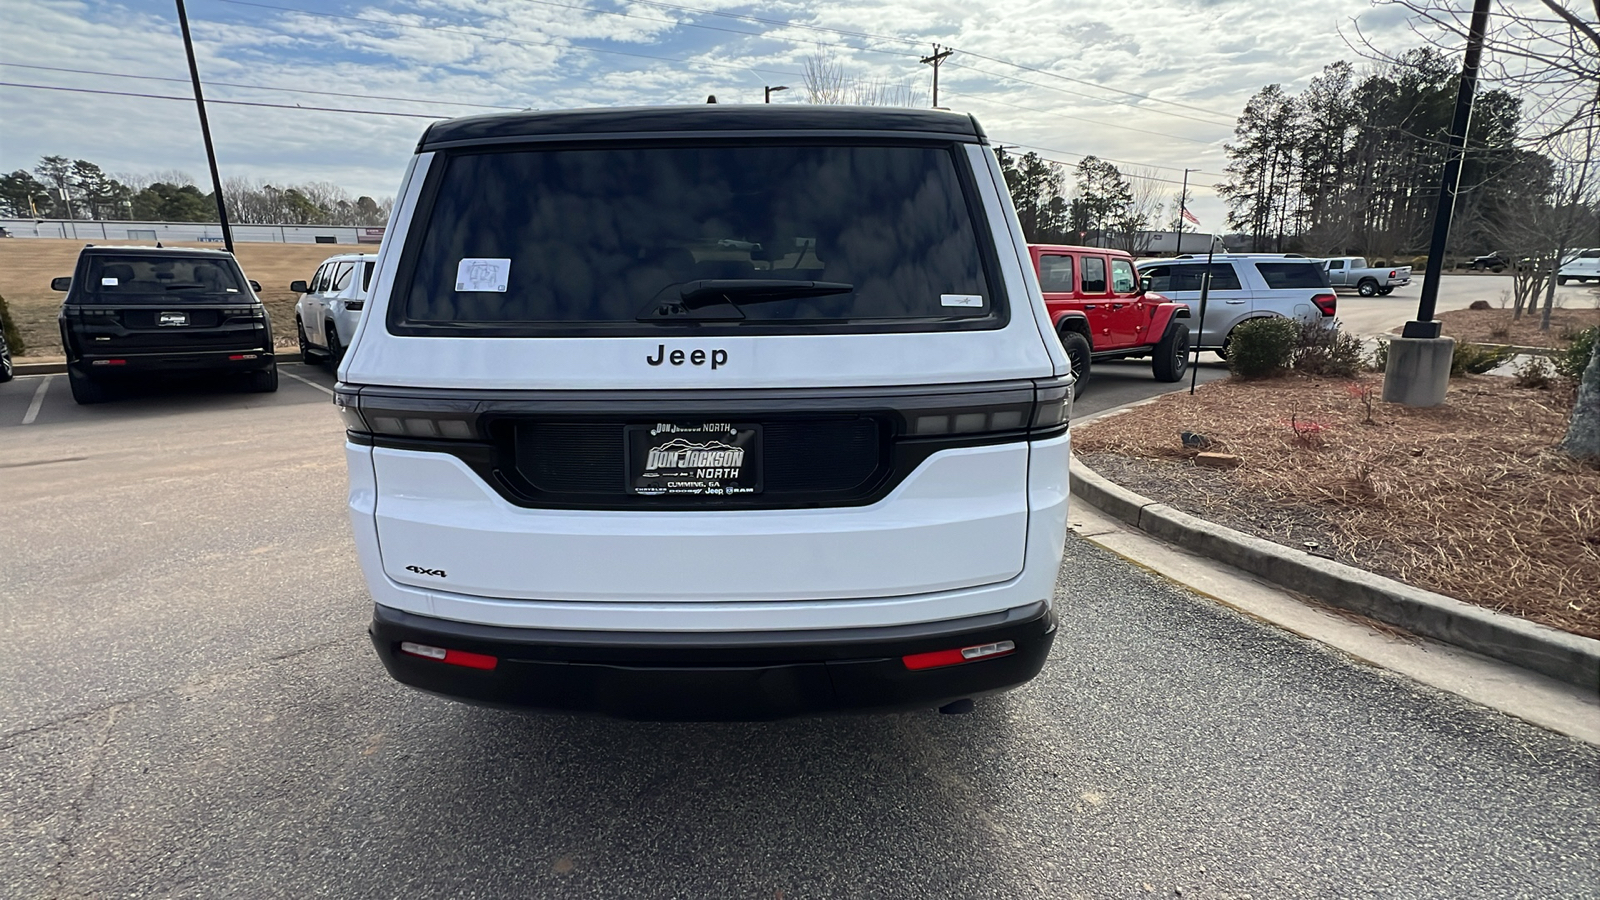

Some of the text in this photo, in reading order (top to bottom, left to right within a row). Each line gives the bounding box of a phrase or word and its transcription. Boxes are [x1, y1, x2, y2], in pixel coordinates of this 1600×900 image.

[646, 344, 728, 370] Jeep
[702, 423, 731, 432] NORTH
[645, 450, 745, 470] DON JACKSON
[696, 469, 739, 479] NORTH
[705, 487, 724, 495] Jeep
[405, 565, 447, 578] 4x4
